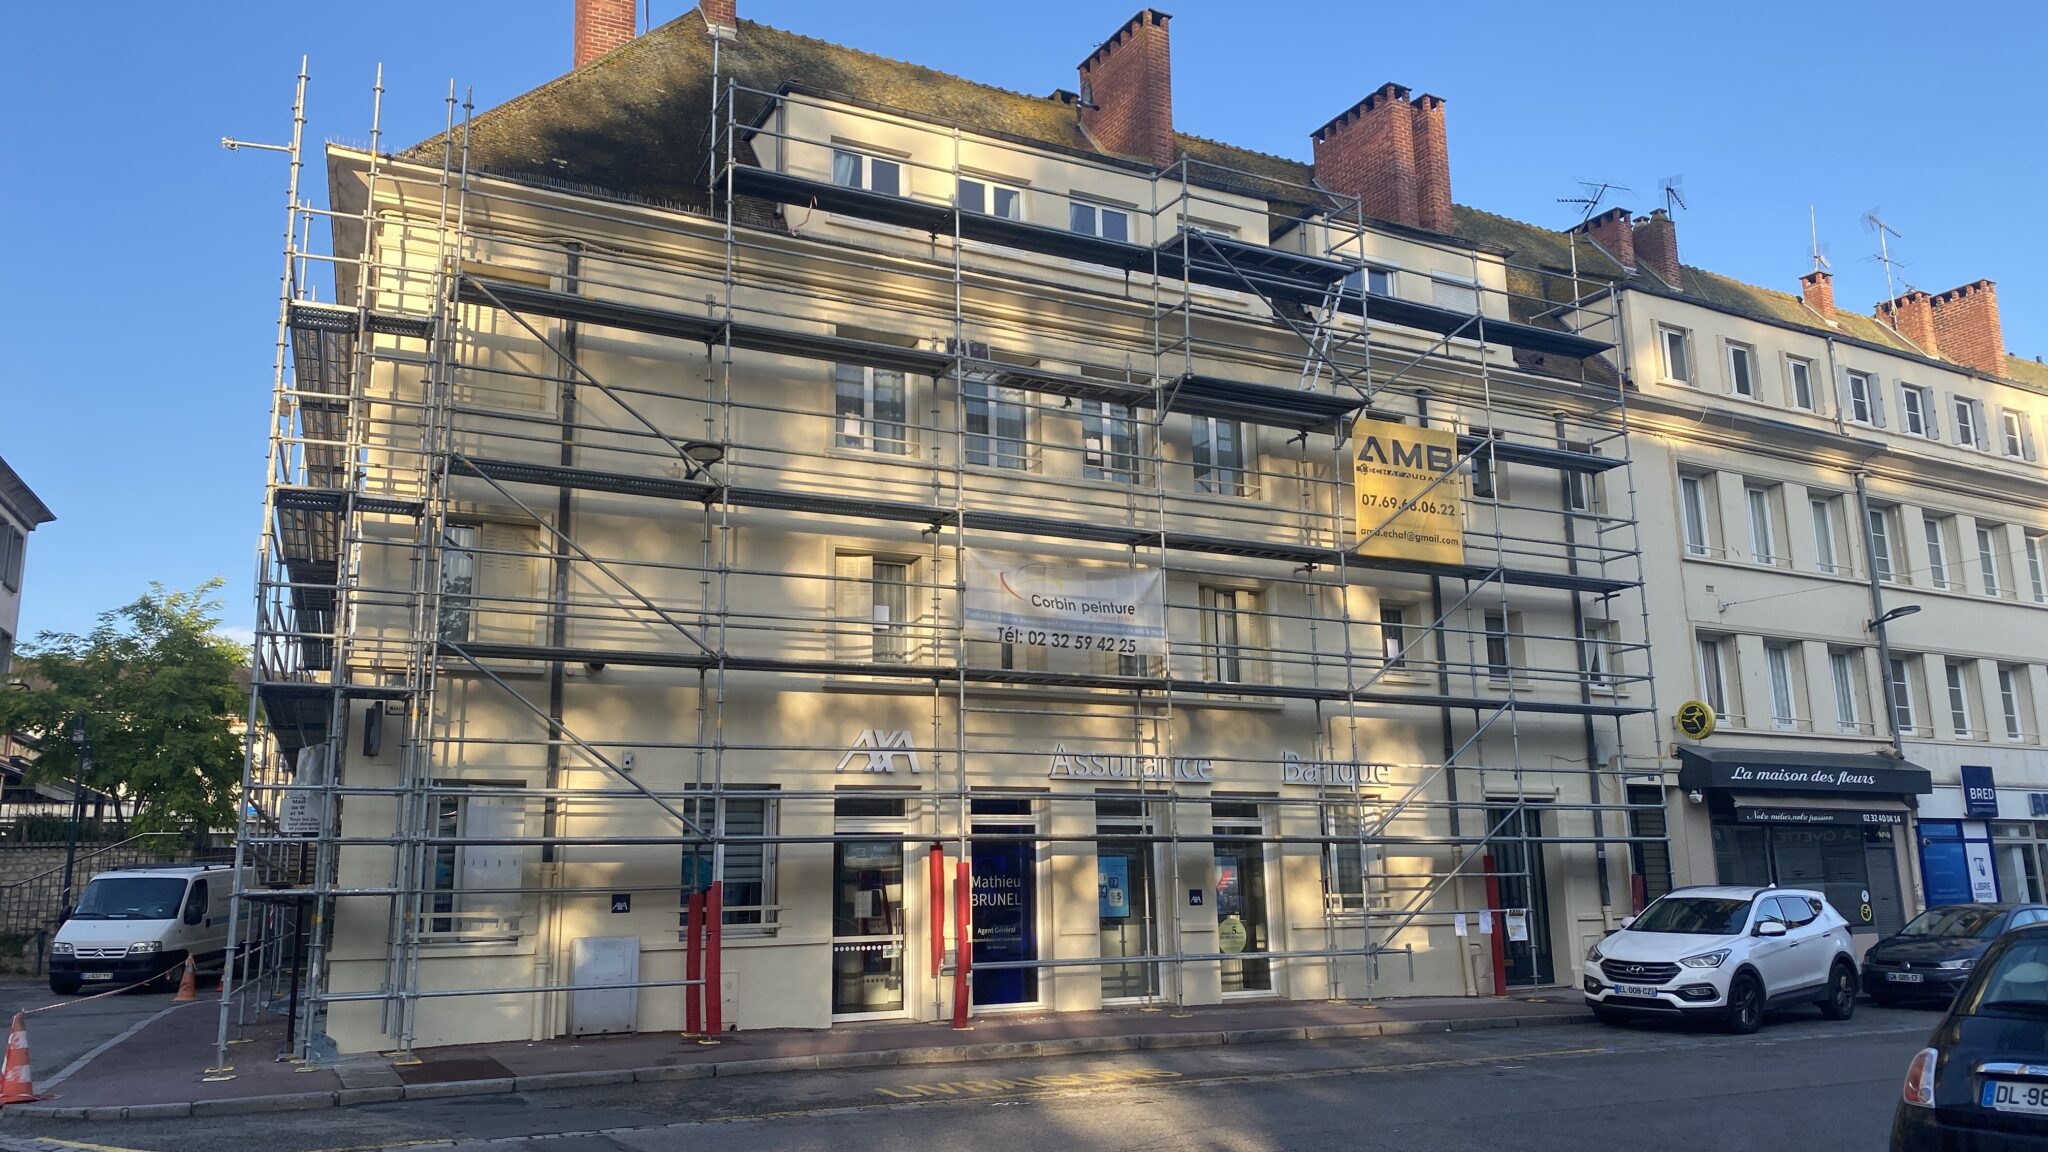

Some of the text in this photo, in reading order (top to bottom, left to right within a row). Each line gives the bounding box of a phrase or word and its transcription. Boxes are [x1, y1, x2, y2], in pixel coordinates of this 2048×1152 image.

[1358, 435, 1454, 473] AMB
[1361, 493, 1455, 517] 07.69.68.06.22
[1360, 527, 1459, 546] amb.echaf@gmail.com
[1031, 594, 1135, 615] Corbin peinture
[997, 626, 1136, 653] Tél: 02 32 59 42 25
[835, 729, 921, 773] AXA
[1049, 743, 1214, 779] Assurance
[1282, 751, 1389, 792] Banque
[1730, 766, 1876, 786] La maison des fleurs
[1969, 787, 1995, 800] BRED
[1746, 808, 1769, 819] Notre
[1808, 813, 1834, 823] passion
[1870, 814, 1878, 822] 32
[971, 875, 1021, 889] Mathieu
[1974, 882, 1991, 891] LIBRE
[612, 902, 628, 910] AXA
[971, 893, 1022, 907] BRUNEL
[1190, 895, 1202, 904] AXA
[977, 926, 1016, 935] Agent Général
